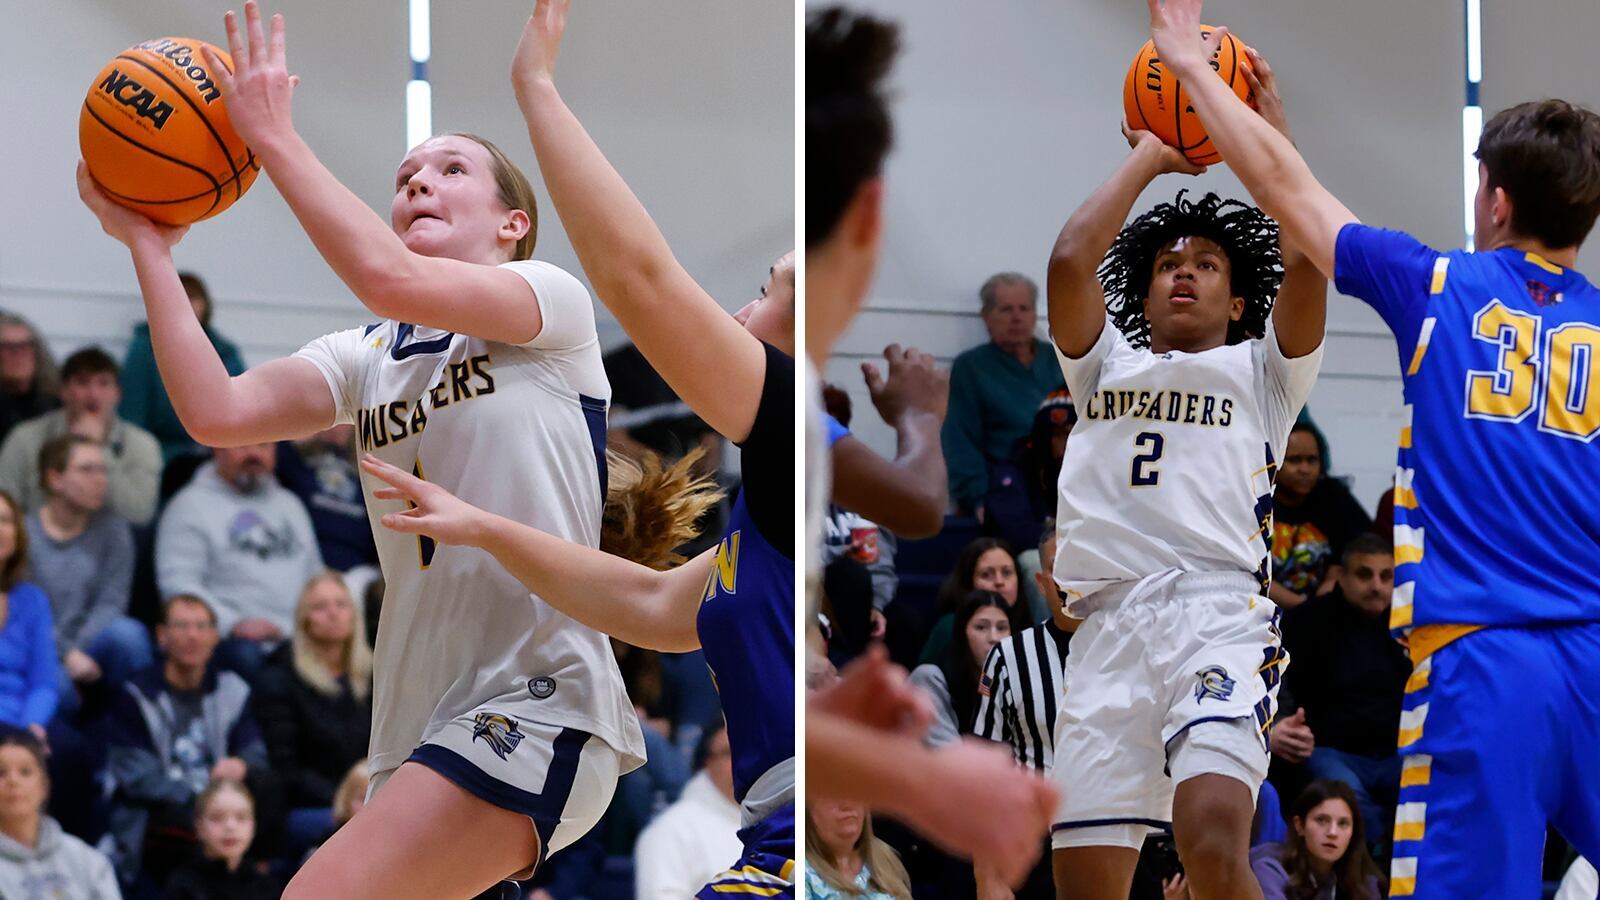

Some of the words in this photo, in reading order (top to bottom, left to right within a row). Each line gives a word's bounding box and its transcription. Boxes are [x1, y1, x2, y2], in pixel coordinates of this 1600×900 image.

[99, 69, 175, 130] NCAA
[1464, 297, 1600, 443] 30
[1086, 390, 1233, 427] CRUSADERS
[1130, 430, 1166, 487] 2
